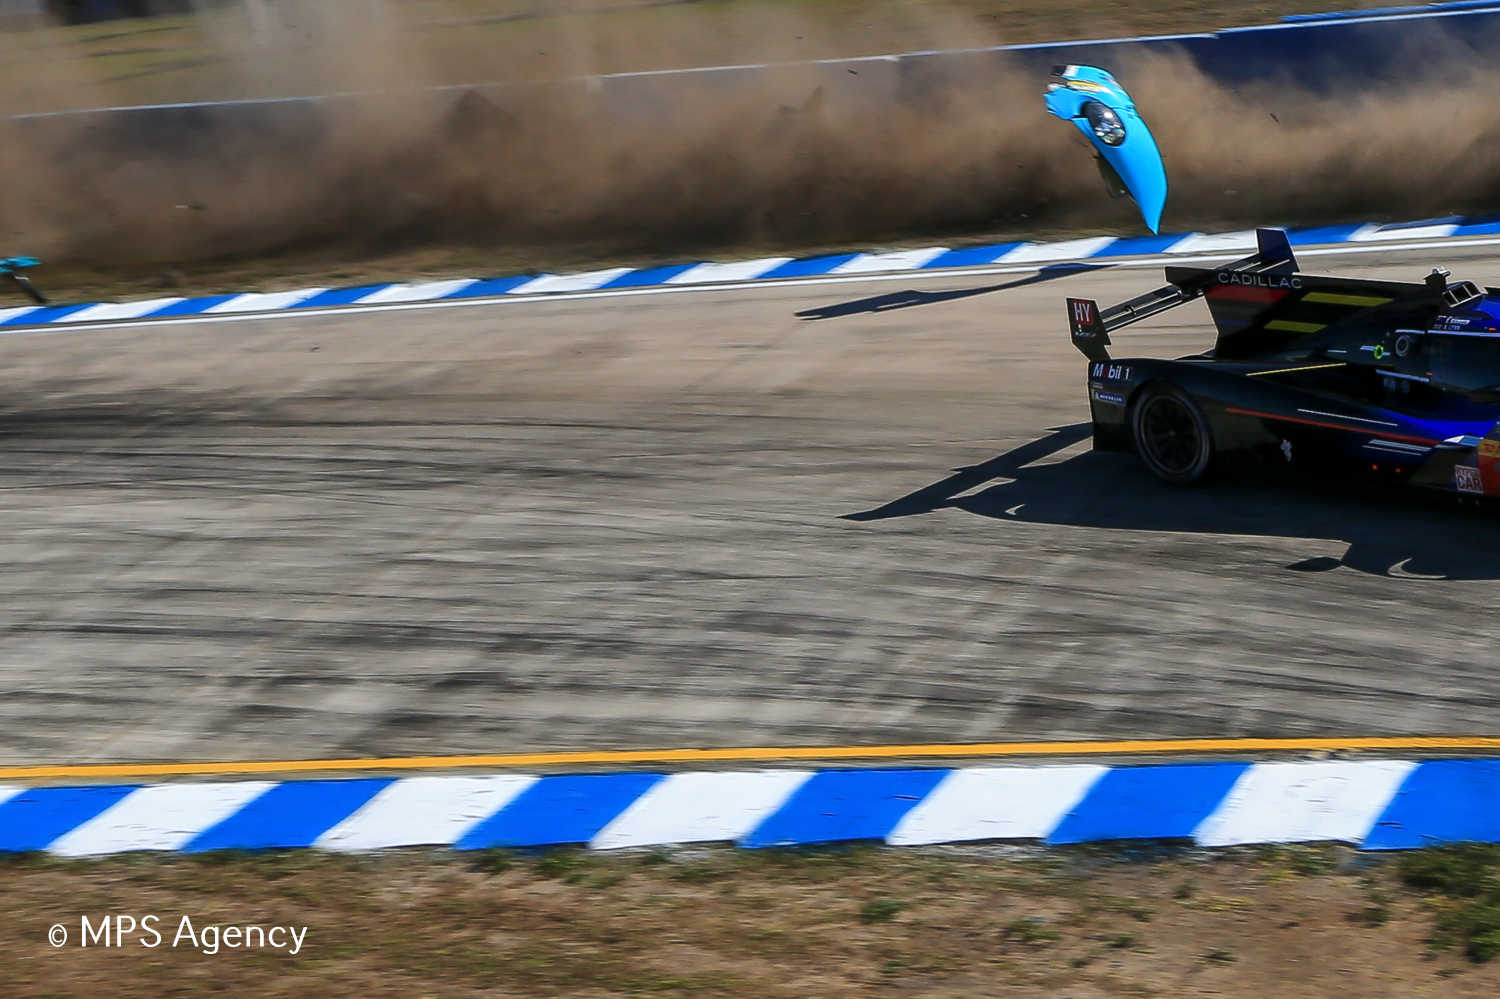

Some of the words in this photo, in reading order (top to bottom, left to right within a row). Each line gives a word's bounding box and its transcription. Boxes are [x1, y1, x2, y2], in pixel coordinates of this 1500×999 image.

[1217, 271, 1302, 289] CADILLAC
[1073, 302, 1090, 322] HY
[1093, 363, 1121, 379] Mobil
[1125, 367, 1130, 380] 1
[1457, 475, 1482, 491] CAR
